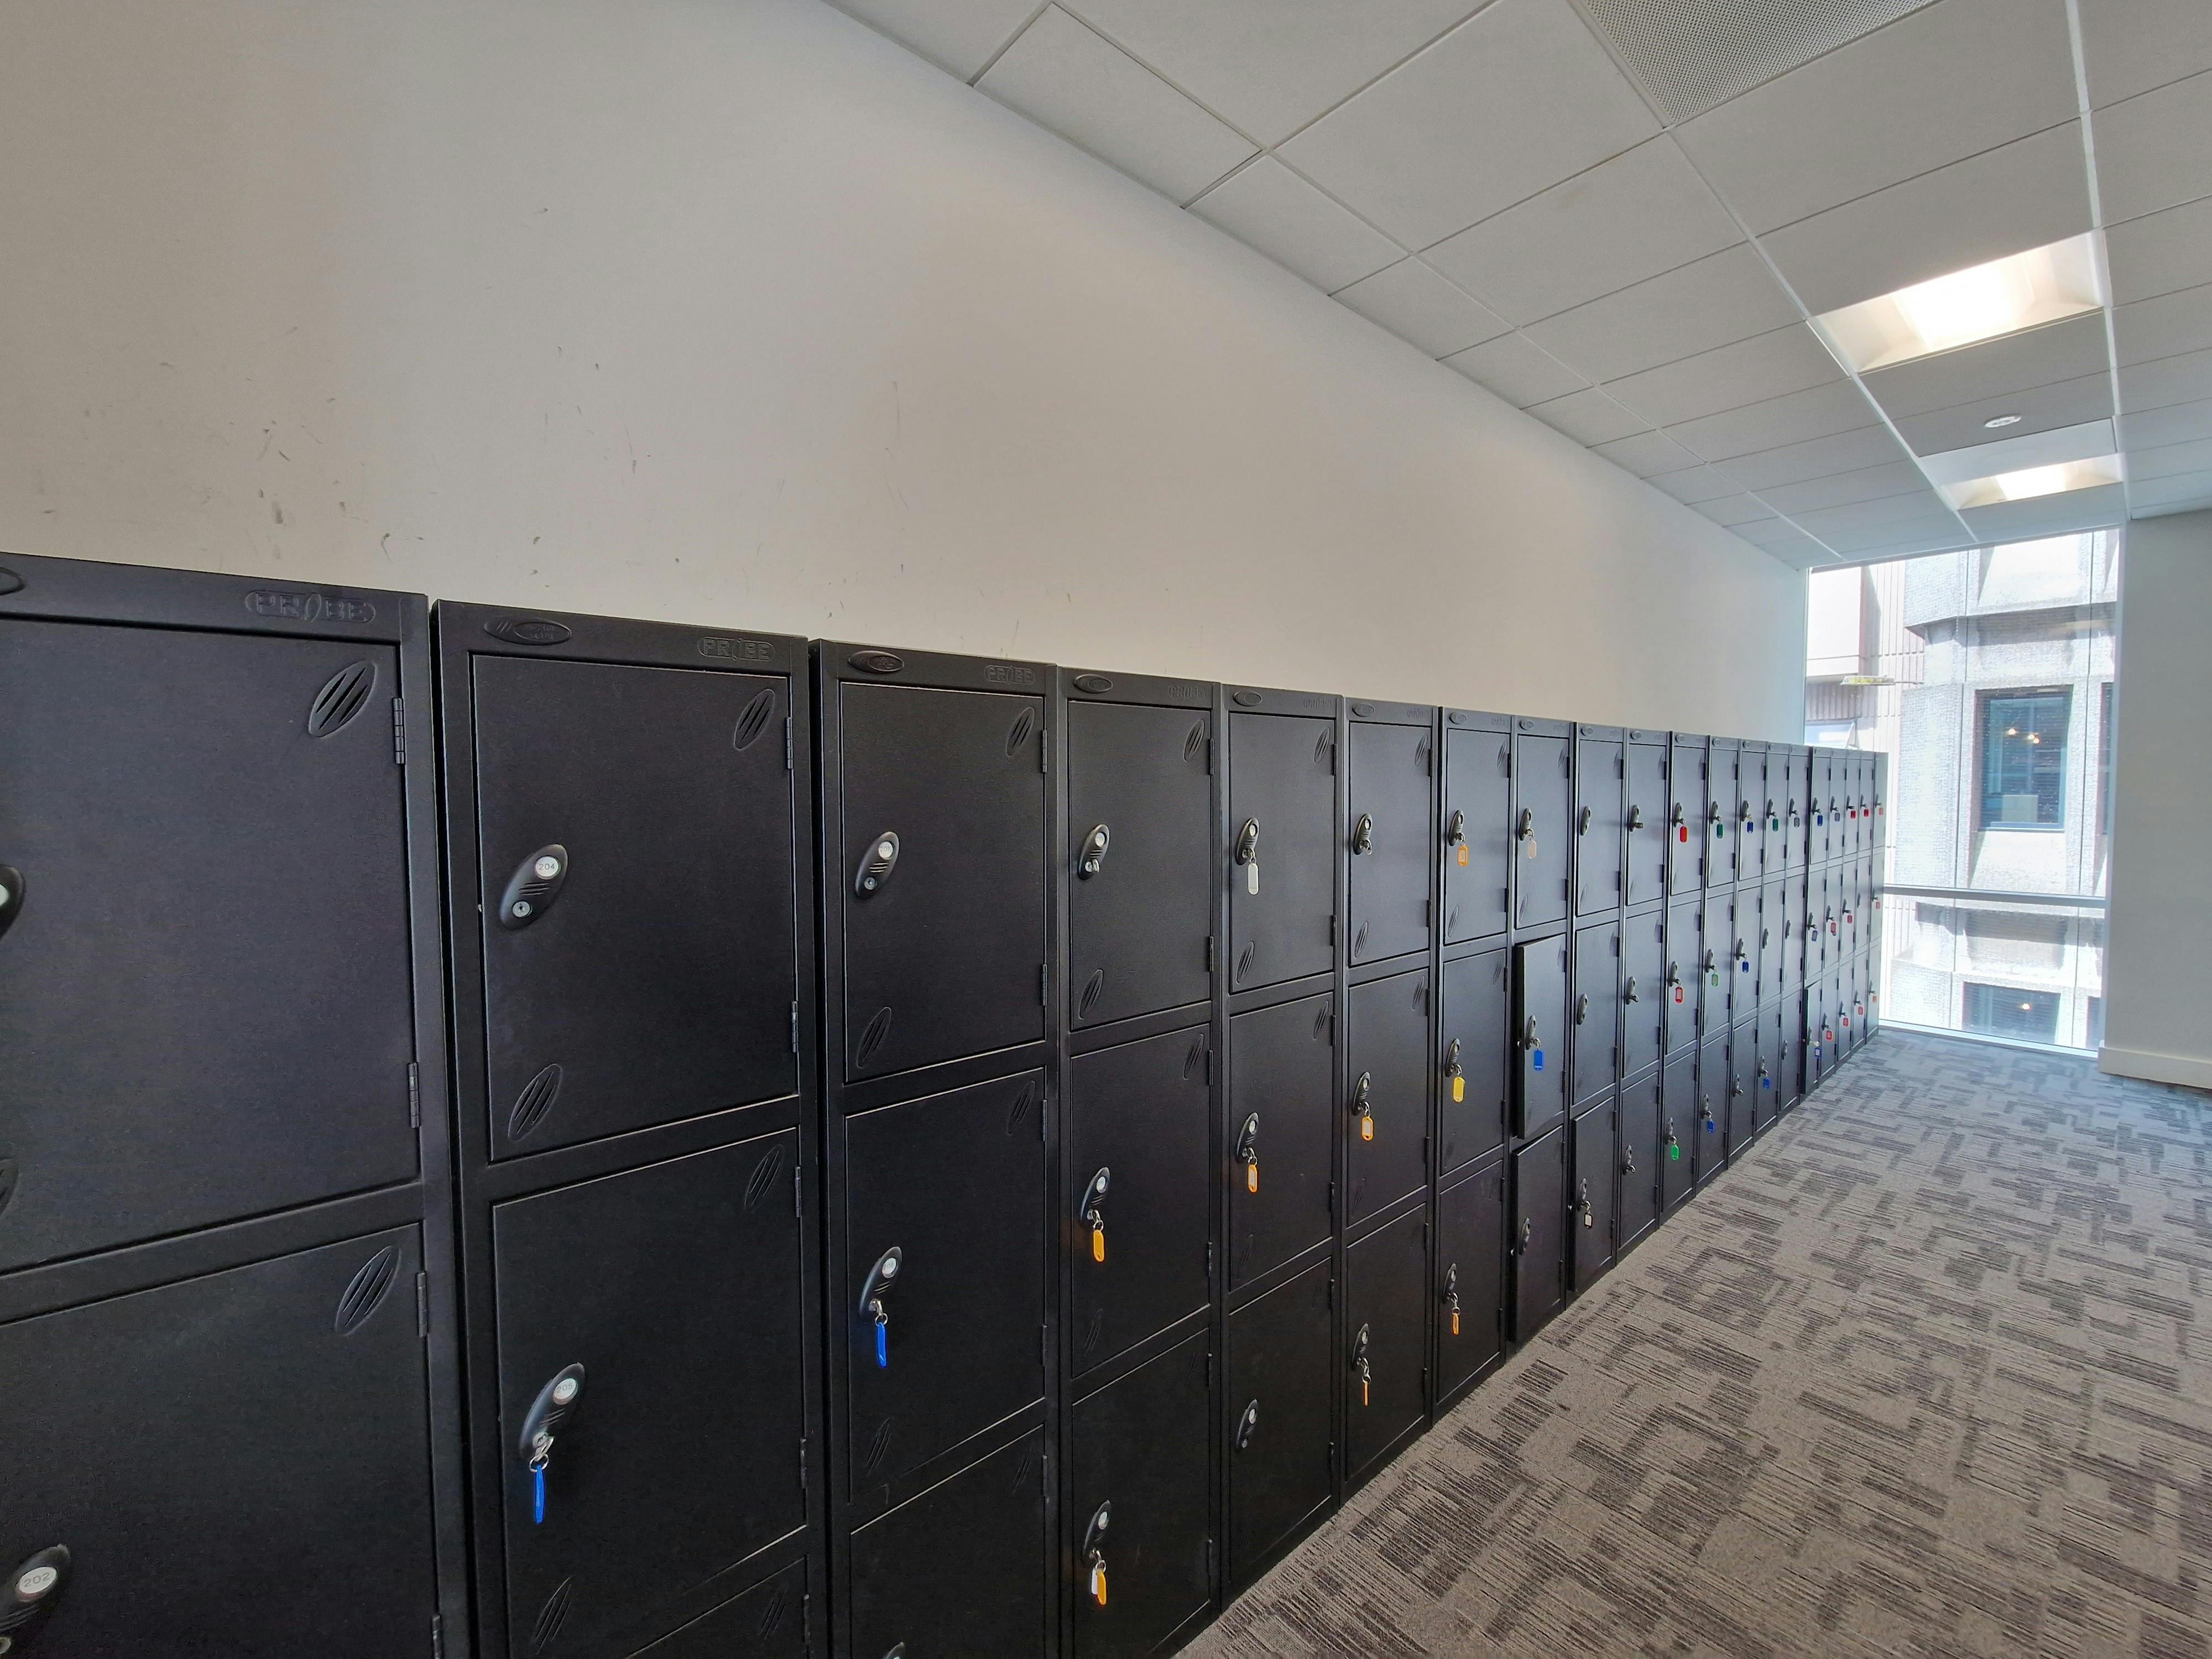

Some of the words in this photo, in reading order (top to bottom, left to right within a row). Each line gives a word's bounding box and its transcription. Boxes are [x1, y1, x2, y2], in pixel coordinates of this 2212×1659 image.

[703, 638, 770, 661] PROBE
[987, 666, 1032, 685] PROBE
[556, 1383, 573, 1393] 205
[24, 1572, 50, 1587] 202
